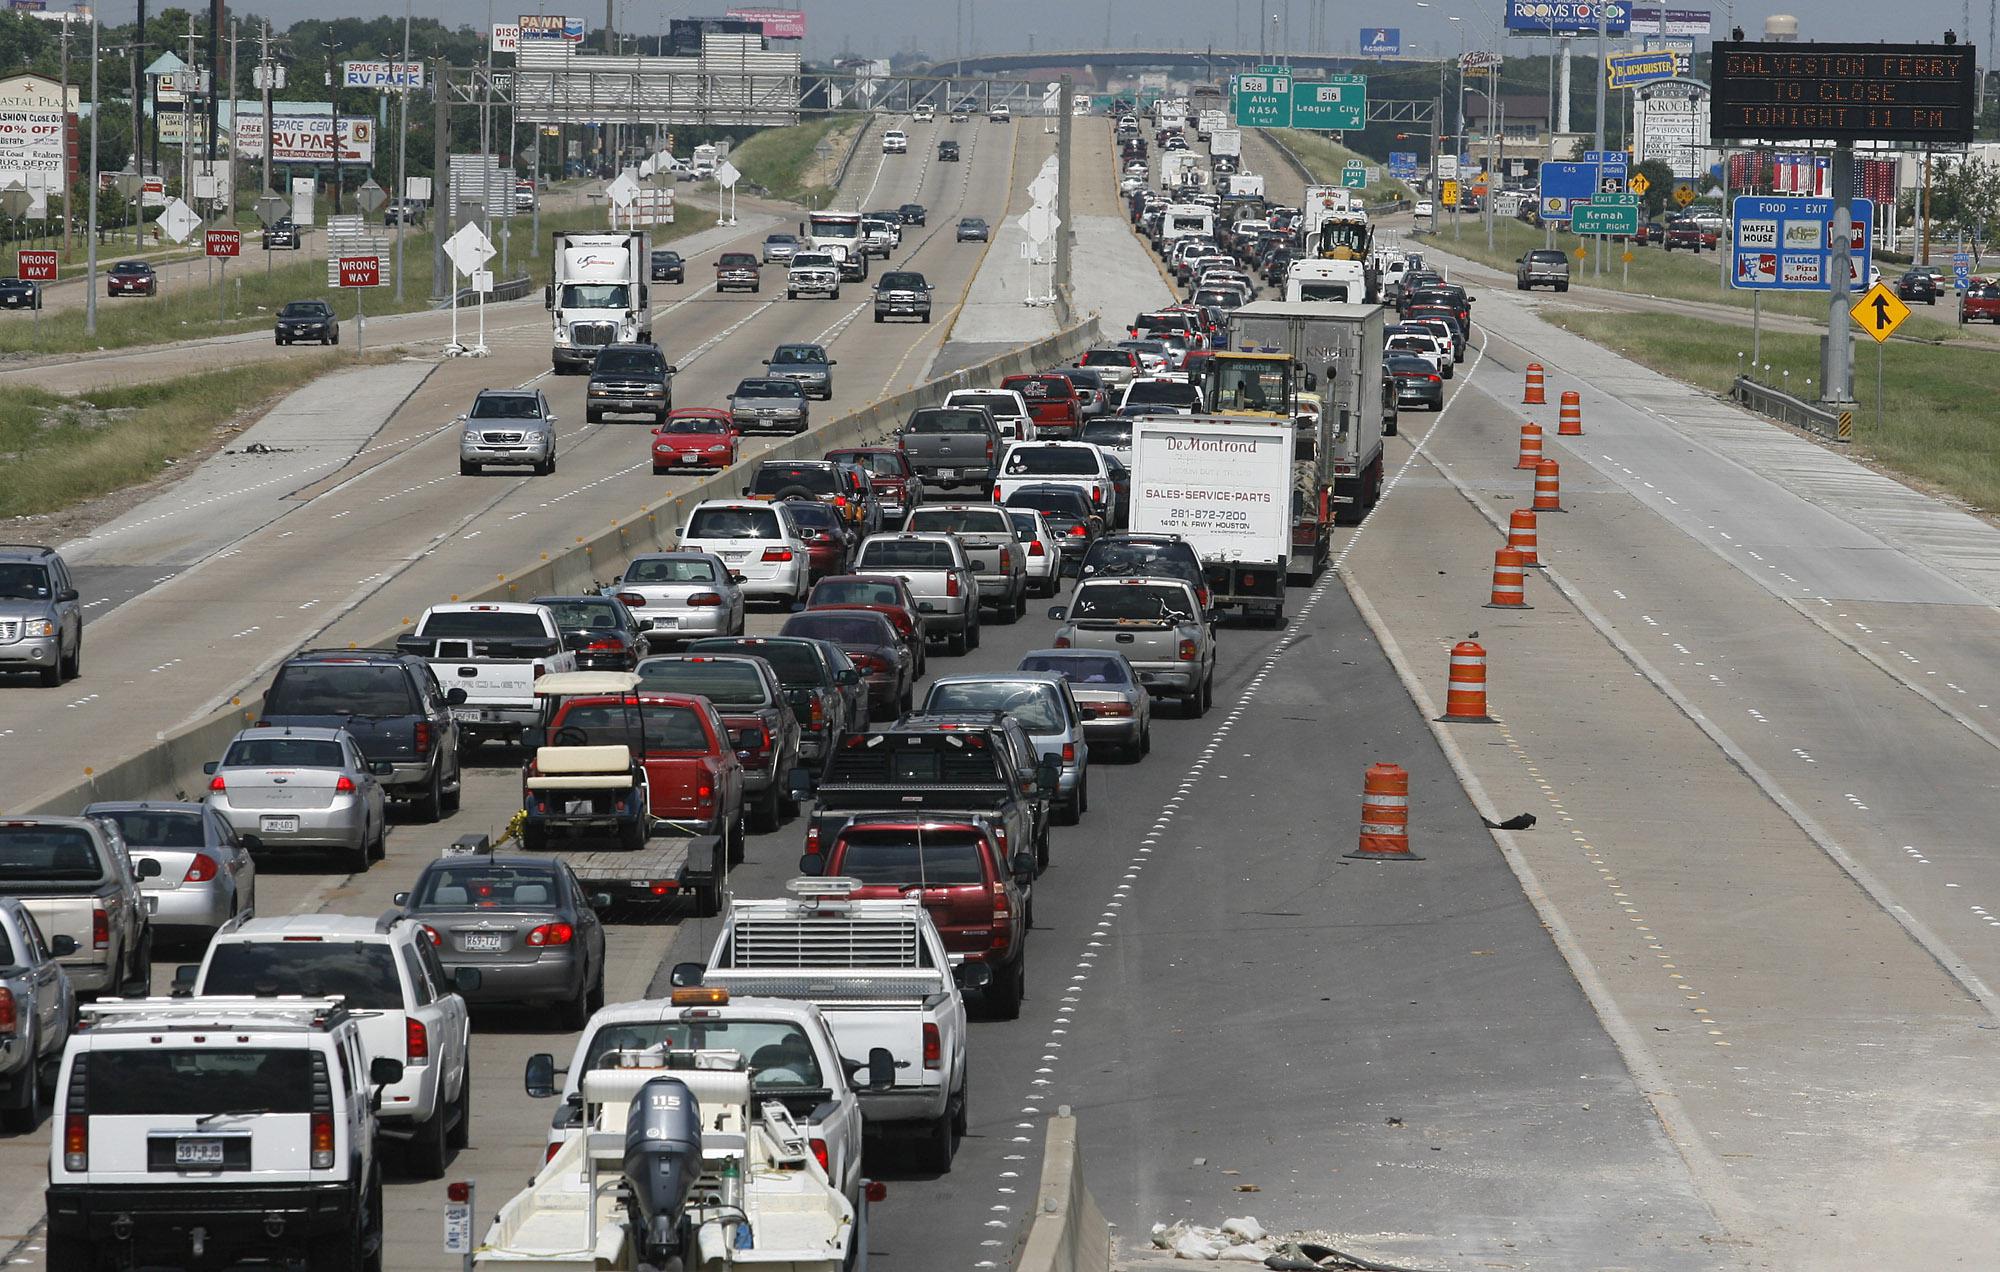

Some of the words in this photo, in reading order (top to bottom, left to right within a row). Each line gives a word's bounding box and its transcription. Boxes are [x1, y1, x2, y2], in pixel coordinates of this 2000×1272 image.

[1515, 4, 1569, 17] ROOMS
[1573, 4, 1590, 18] TO
[1593, 5, 1618, 18] GO
[520, 16, 563, 28] PAWN
[499, 40, 515, 48] TIR
[1363, 45, 1397, 53] Academy
[349, 64, 379, 72] SPACE
[383, 64, 419, 72] CENER
[1617, 62, 1672, 76] BLOCKBUSTER
[1727, 56, 1865, 76] GALVESTON
[1884, 58, 1963, 77] FERRY
[348, 73, 370, 84] RV
[375, 73, 419, 85] PARK
[1245, 82, 1262, 90] 528
[1774, 82, 1800, 99] TO
[1821, 83, 1896, 101] CLOSE
[1251, 96, 1277, 104] Alvin
[1322, 92, 1337, 101] 518
[0, 96, 35, 106] ASTAL
[39, 96, 74, 107] PLAA
[1648, 100, 1698, 112] KROGER
[1248, 106, 1278, 114] NASA
[1297, 105, 1332, 113] League
[1339, 105, 1360, 114] City
[0, 113, 27, 122] ASHION
[29, 114, 50, 122] CLOSE
[1742, 107, 1848, 126] TONIGHT
[1869, 109, 1892, 127] 11
[1914, 110, 1943, 127] PM
[31, 126, 59, 134] OFF
[241, 125, 262, 133] FREE
[272, 120, 304, 131] SPACE
[310, 121, 348, 132] CENER
[273, 133, 296, 148] RV
[301, 134, 348, 150] PARK
[1611, 153, 1623, 162] 23
[1619, 195, 1634, 204] 23
[1760, 203, 1786, 212] FOOD
[1806, 204, 1827, 214] EXIT
[1587, 211, 1623, 220] Kemah
[1606, 223, 1630, 231] RIGHT
[1742, 225, 1775, 233] WAFFLE
[207, 234, 239, 244] WRONG
[1744, 234, 1773, 242] HOUSE
[213, 244, 233, 254] WAY
[21, 256, 56, 267] WRONG
[1784, 256, 1818, 264] VILLAGE
[341, 261, 377, 271] WRONG
[27, 268, 50, 278] WAY
[1956, 267, 1968, 276] 45
[348, 272, 370, 283] WAY
[1784, 274, 1818, 282] Seafood
[1306, 347, 1356, 358] KNIGHT
[1171, 509, 1247, 521] 281-872-7200
[1191, 521, 1212, 529] FRWY
[440, 680, 526, 689] EVROLET
[651, 1095, 681, 1106] 115
